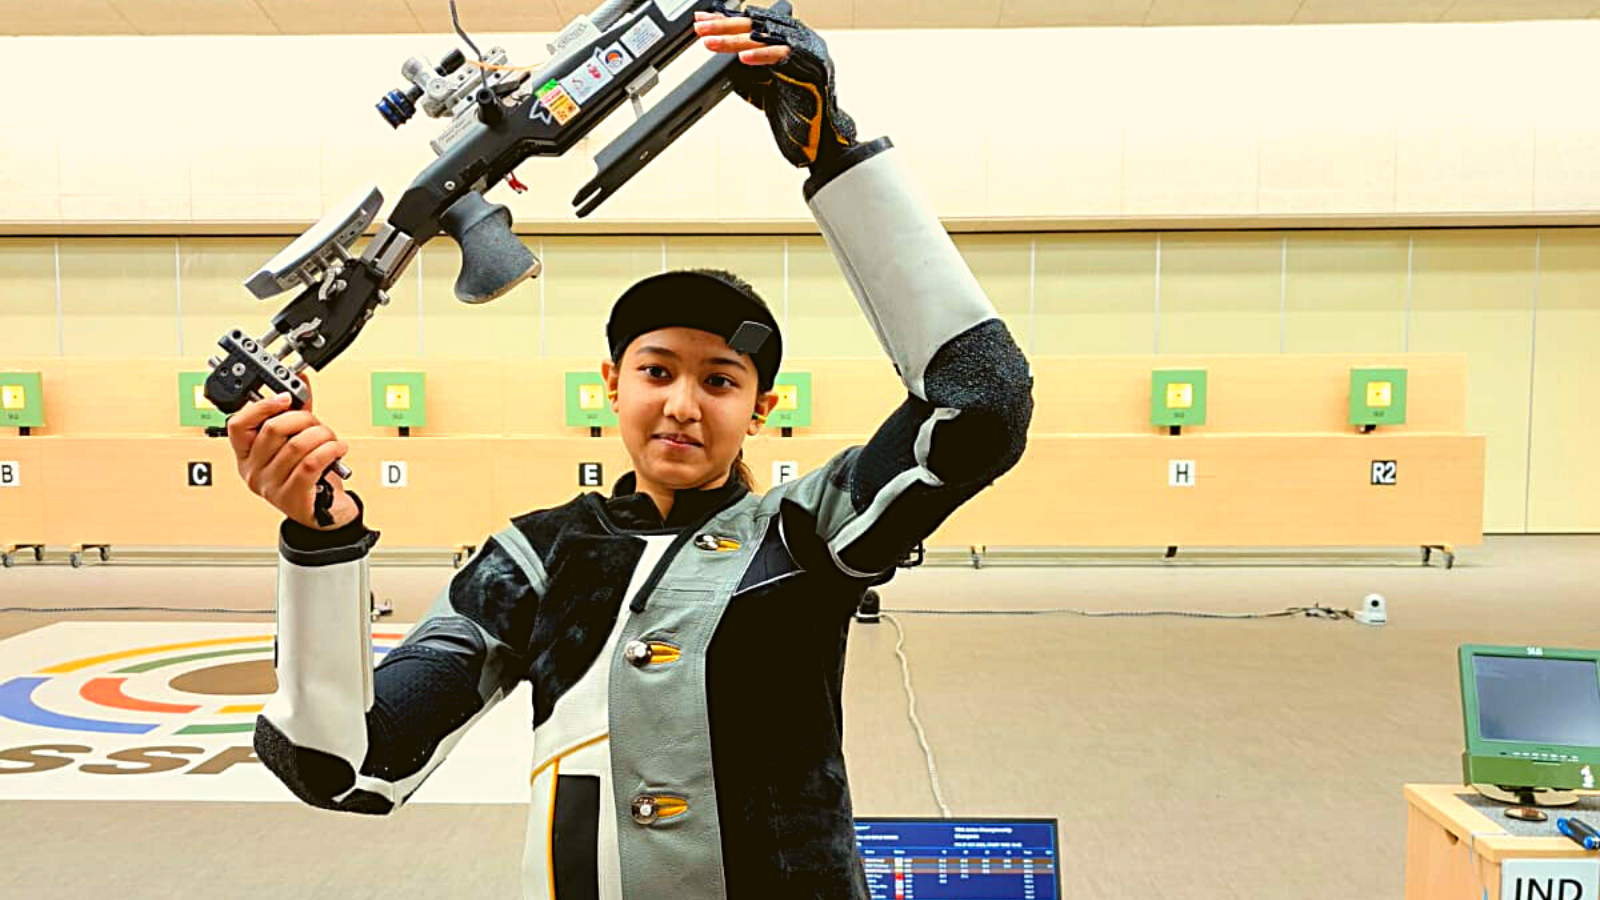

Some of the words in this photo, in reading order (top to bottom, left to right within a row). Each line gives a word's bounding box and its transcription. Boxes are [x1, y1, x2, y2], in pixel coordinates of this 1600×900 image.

[1, 465, 13, 483] B
[192, 463, 208, 484] C
[388, 465, 401, 483] D
[584, 464, 598, 484] E
[780, 465, 790, 483] F
[1176, 463, 1189, 483] H
[1373, 462, 1396, 483] R2
[1515, 878, 1583, 900] IND
